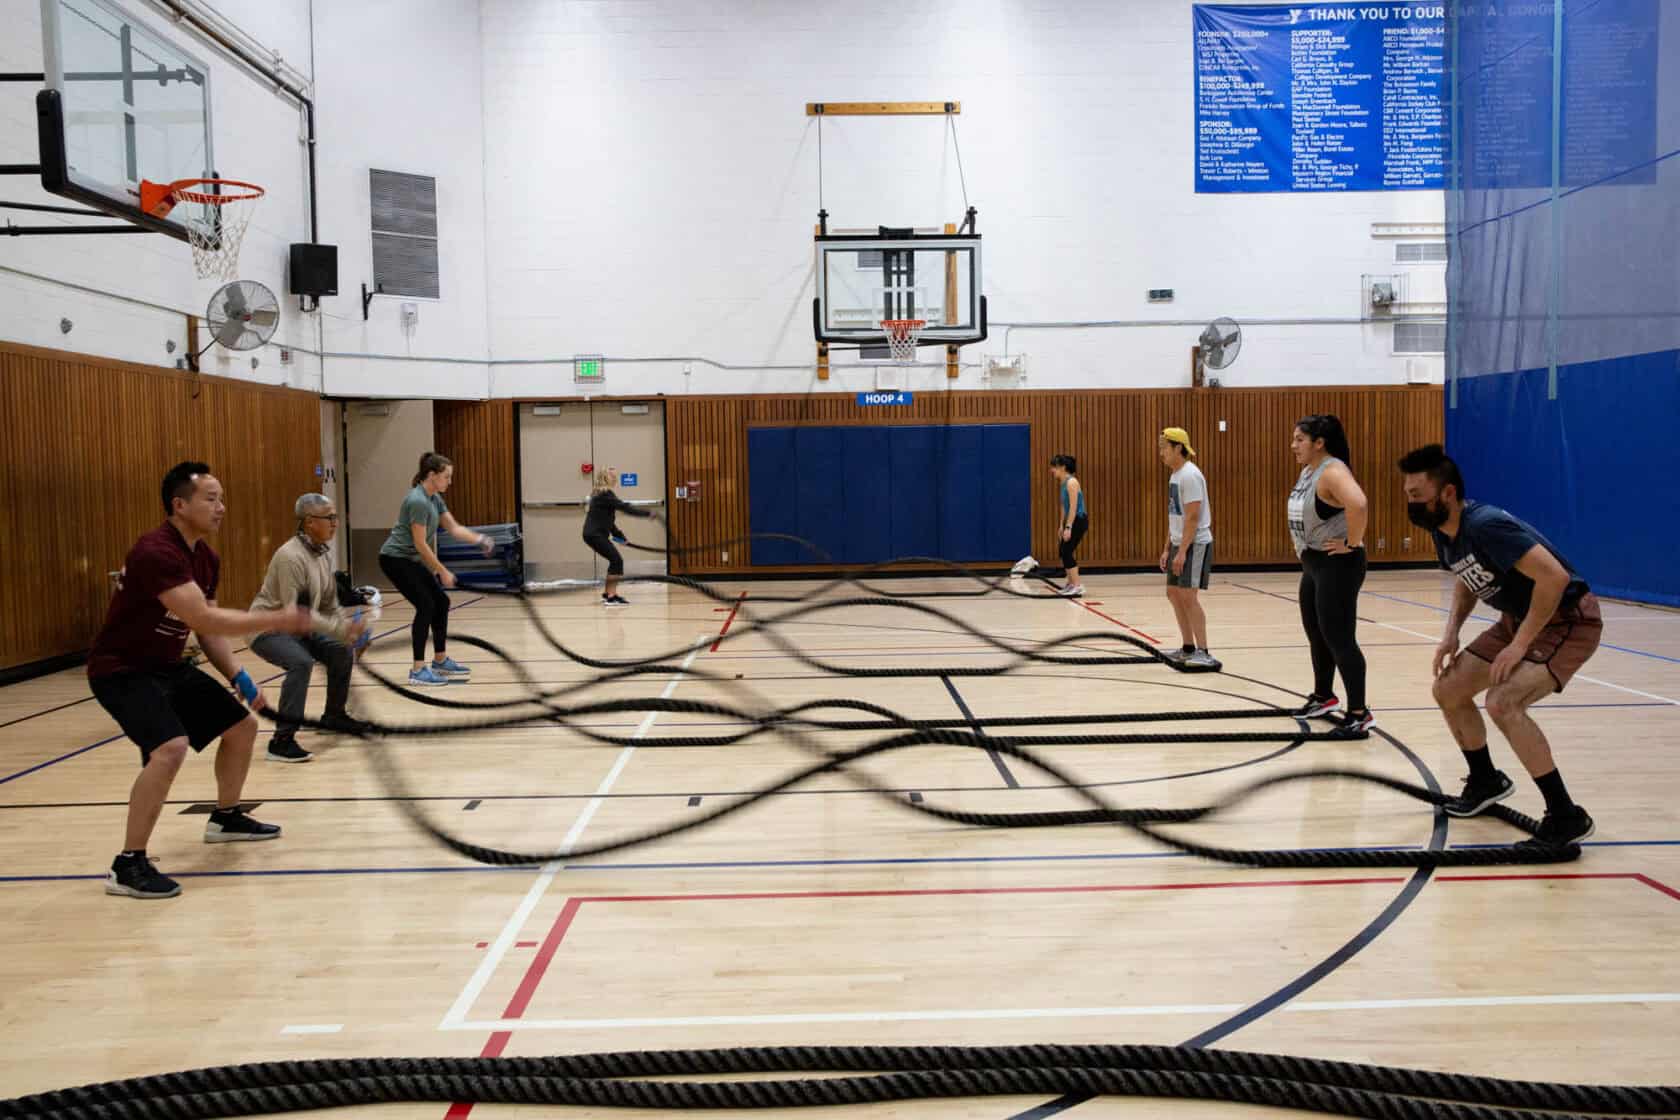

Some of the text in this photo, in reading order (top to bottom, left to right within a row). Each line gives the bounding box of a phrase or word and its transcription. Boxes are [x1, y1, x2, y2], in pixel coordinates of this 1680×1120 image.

[1308, 8, 1355, 20] THANK
[1359, 8, 1388, 20] YOU
[1392, 8, 1411, 19] TO
[1415, 7, 1444, 19] OUR
[865, 394, 904, 404] HOOP 4
